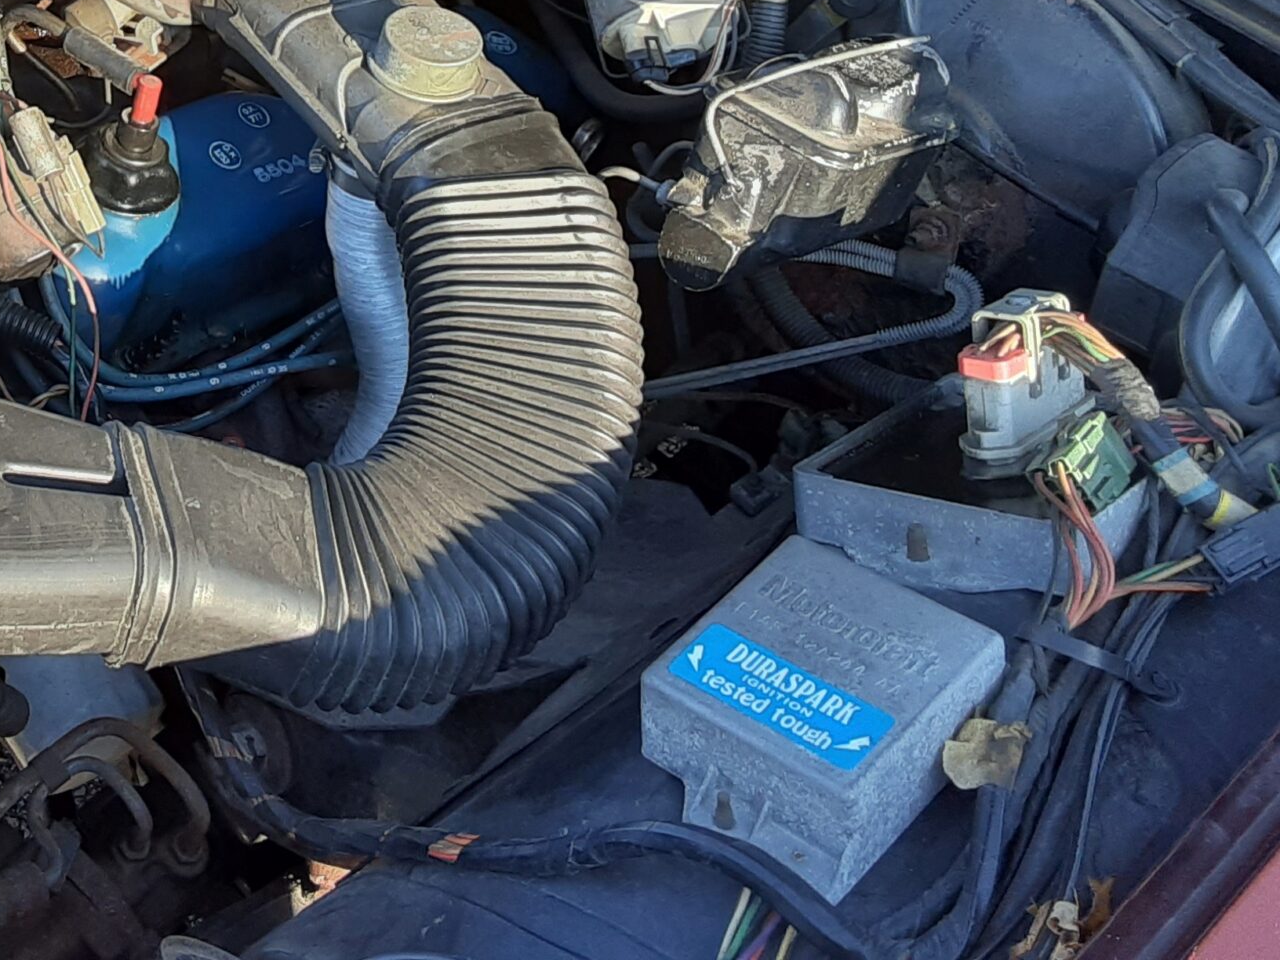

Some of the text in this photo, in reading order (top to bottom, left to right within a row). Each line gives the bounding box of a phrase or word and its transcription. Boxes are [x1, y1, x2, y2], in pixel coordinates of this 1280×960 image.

[759, 574, 940, 680] Motorcraft
[701, 668, 834, 751] tested tough
[725, 641, 862, 726] DURASPARK
[742, 673, 814, 720] IGNITION
